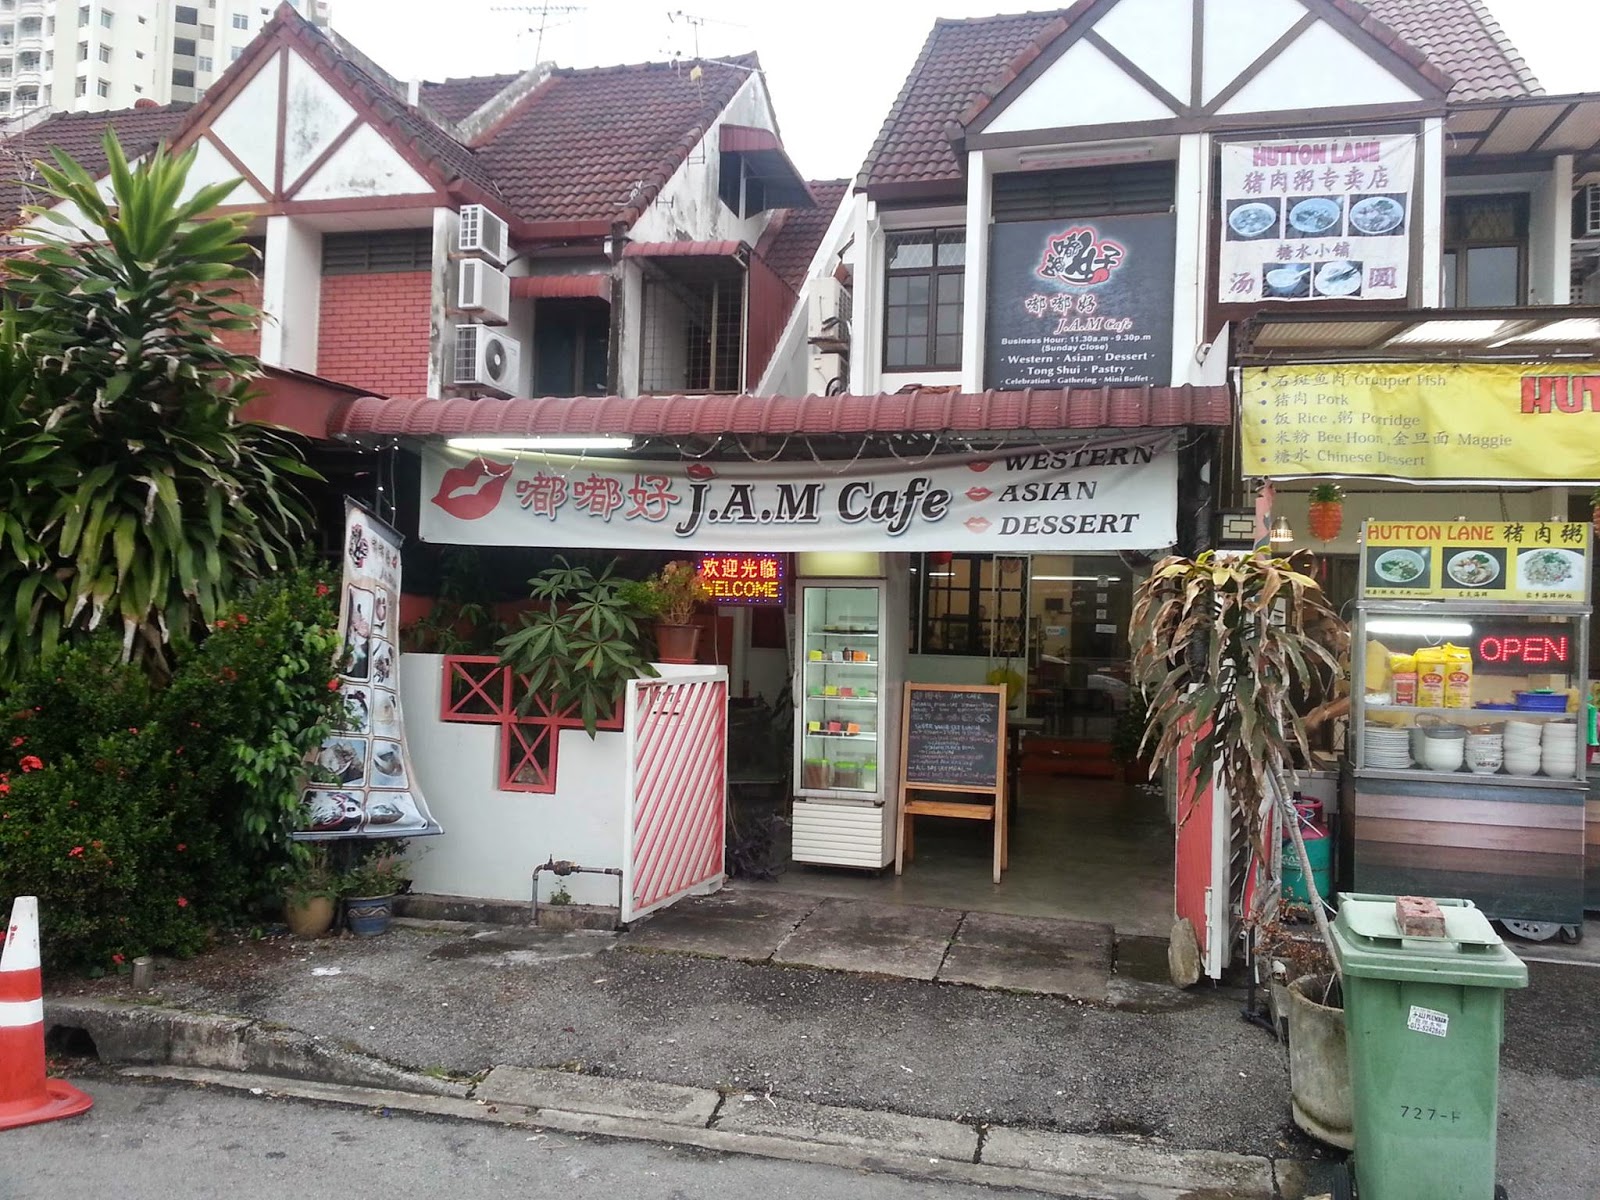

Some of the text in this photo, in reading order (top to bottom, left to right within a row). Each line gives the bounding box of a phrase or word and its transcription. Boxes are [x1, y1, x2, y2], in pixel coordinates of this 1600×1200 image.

[1253, 142, 1381, 167] HUTTON LANE
[1242, 166, 1390, 194] 猪肉粥专卖店
[1024, 294, 1097, 317] 嘟嘟好
[1054, 317, 1134, 335] J.A.M Cafe
[1001, 338, 1042, 346] Business
[1043, 336, 1068, 344] Hour:
[1070, 335, 1109, 343] 11.30a.m
[1116, 334, 1152, 343] 9.30p.m
[1041, 343, 1109, 354] (Sunday Close)
[1008, 352, 1148, 364] Western Asian Dessert
[1005, 374, 1149, 385] Celebration Gathering Mini Buffet
[1027, 364, 1126, 376] Tong Shui Pastry
[1354, 374, 1411, 390] Grouper
[1417, 374, 1447, 387] Fish
[1274, 391, 1349, 407] 猪肉 Pork
[1272, 412, 1291, 426] 饭
[1298, 413, 1328, 424] Rice
[1361, 413, 1420, 429] Porridge
[1276, 430, 1311, 445] 米粉
[1317, 430, 1342, 444] Bee
[1346, 432, 1384, 444] Hoon
[1458, 433, 1513, 449] Maggie
[1004, 444, 1156, 472] WESTERN
[1317, 450, 1373, 464] Chinese
[1377, 452, 1426, 467] Dessert
[998, 480, 1099, 503] ASIAN
[515, 470, 954, 538] 嘟嘟好 J.A.M Cafe
[998, 513, 1140, 536] DESSERT
[1367, 522, 1584, 544] HUTTON LANE 猪肉粥
[702, 558, 778, 579] 欢迎光临
[1479, 636, 1569, 664] OPEN
